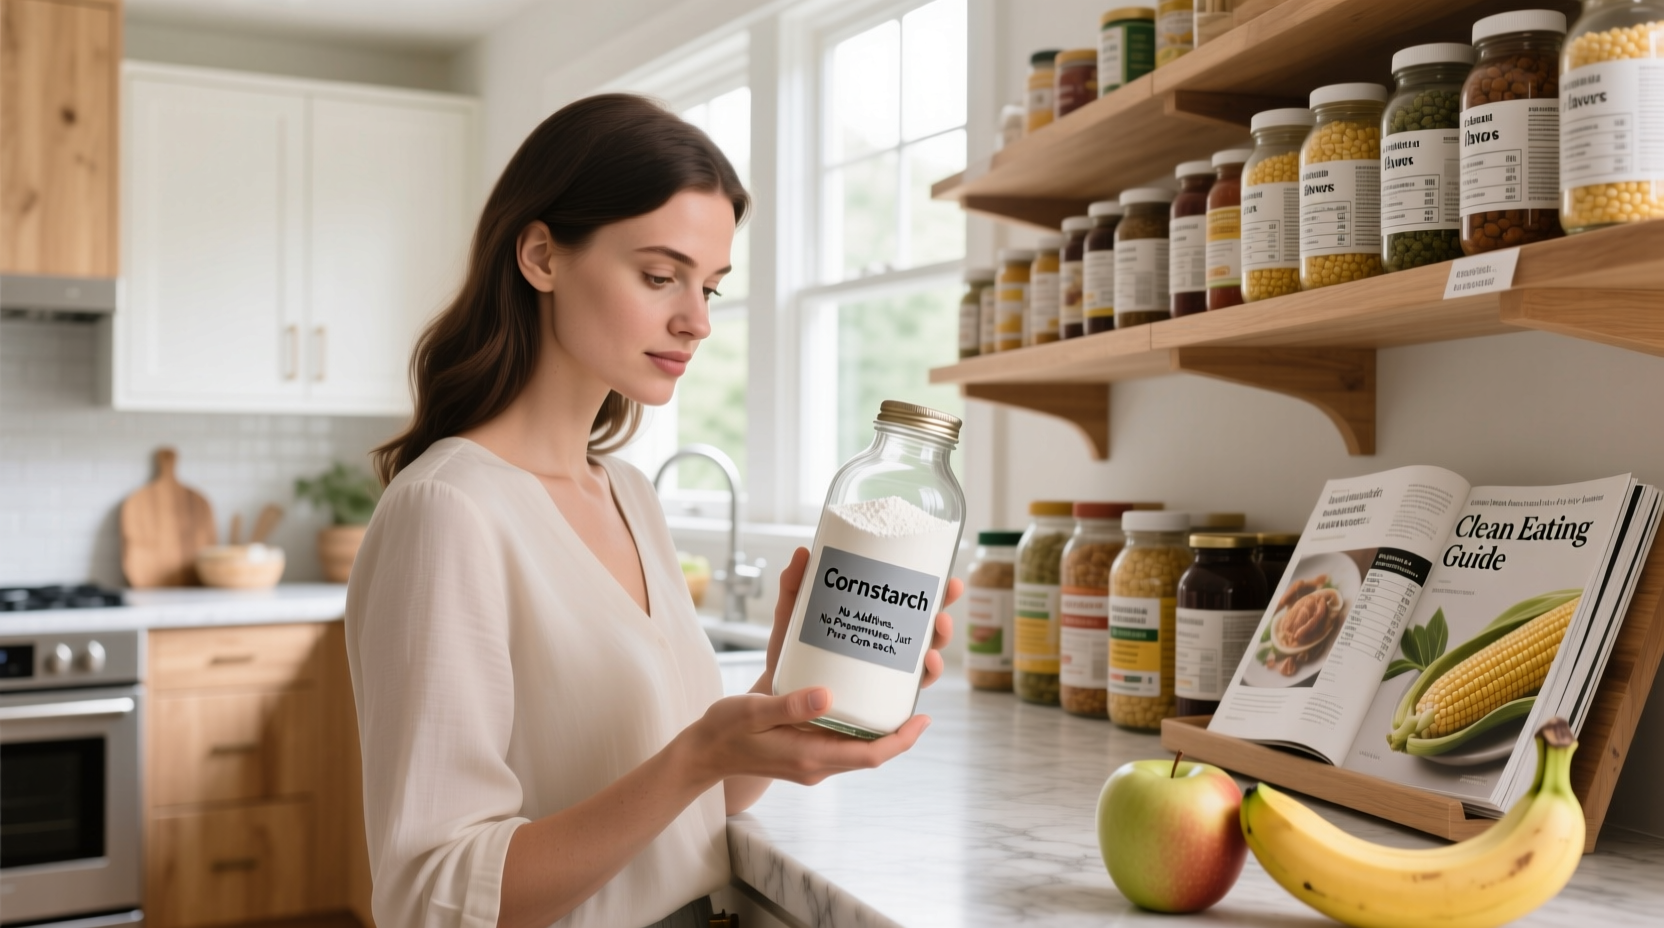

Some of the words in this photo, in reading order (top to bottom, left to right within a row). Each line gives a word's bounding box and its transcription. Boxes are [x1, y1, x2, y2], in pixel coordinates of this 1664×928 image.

[1455, 514, 1514, 540] Clean
[1516, 515, 1594, 548] Eating
[1442, 544, 1507, 571] Guide
[824, 567, 929, 612] Cornstarch
